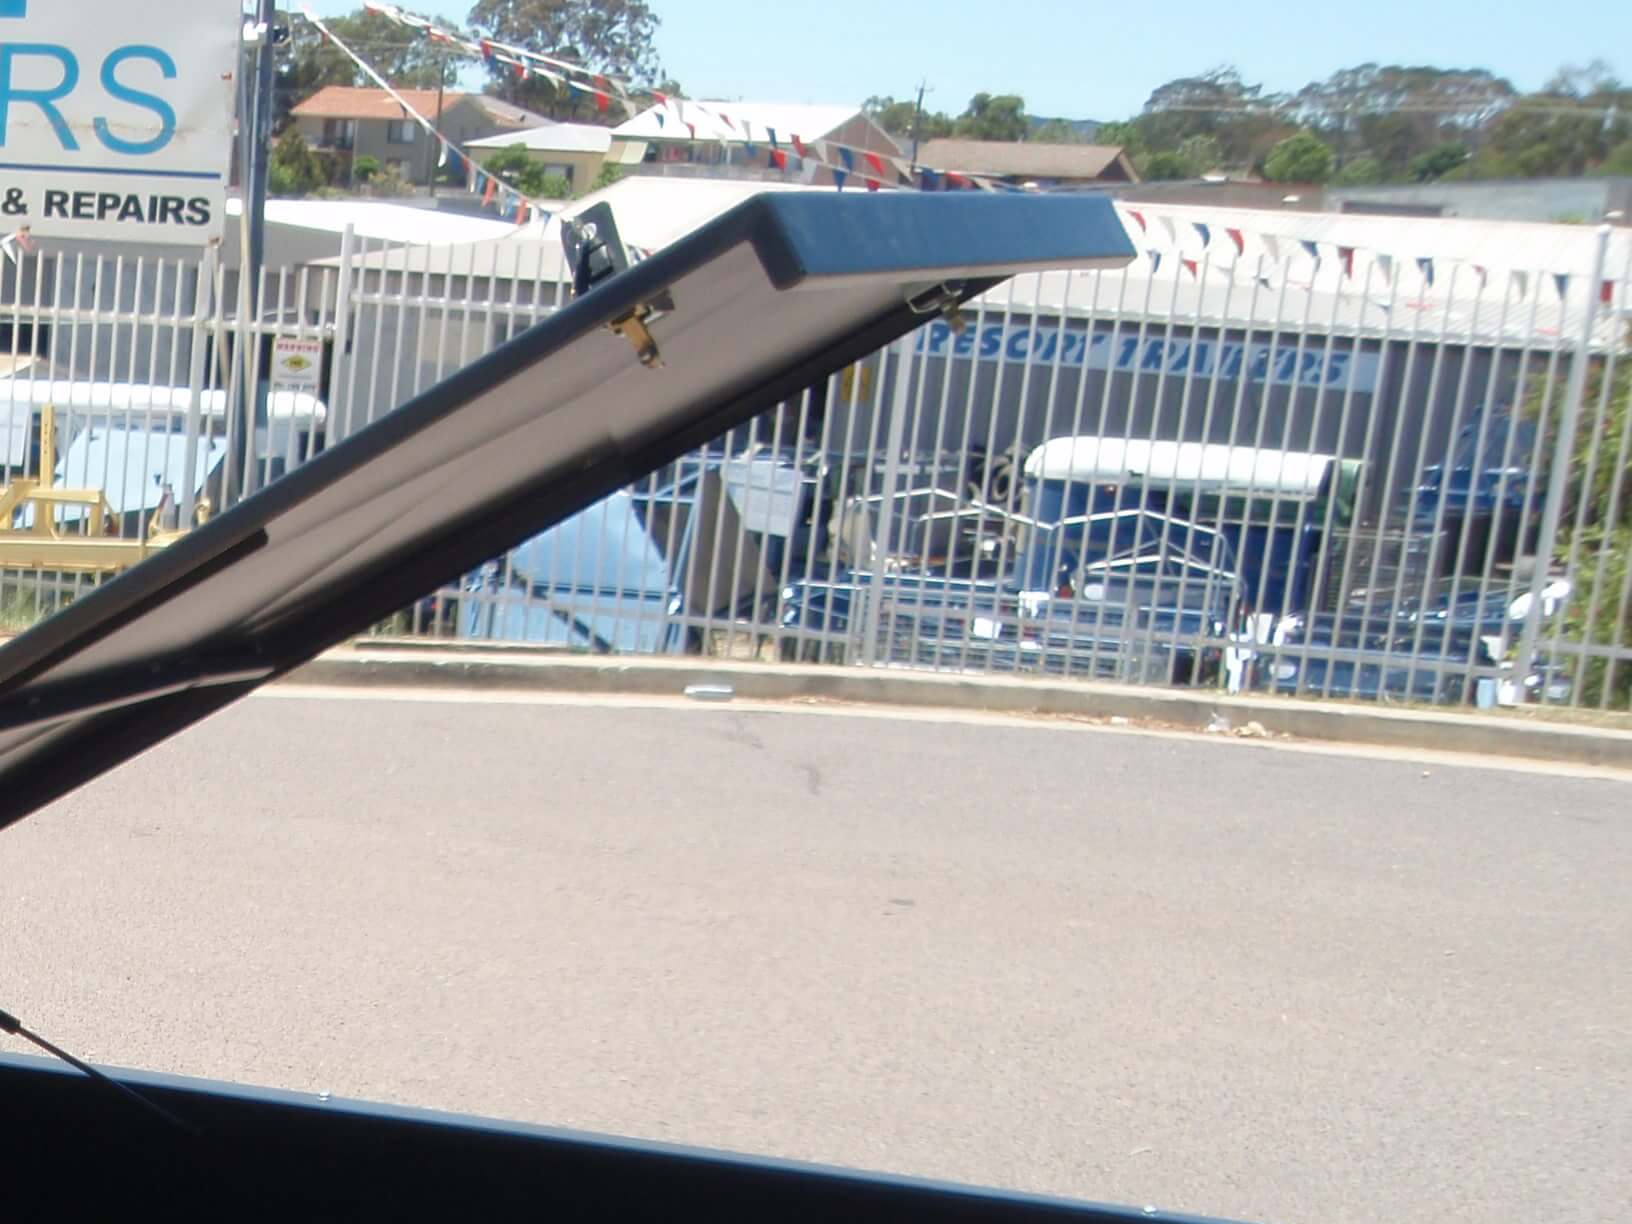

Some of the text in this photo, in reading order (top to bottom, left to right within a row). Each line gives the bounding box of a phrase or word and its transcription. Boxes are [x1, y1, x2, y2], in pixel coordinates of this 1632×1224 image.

[1, 185, 28, 215] &
[43, 190, 211, 226] REPAIRS
[915, 320, 1108, 364] RESORT
